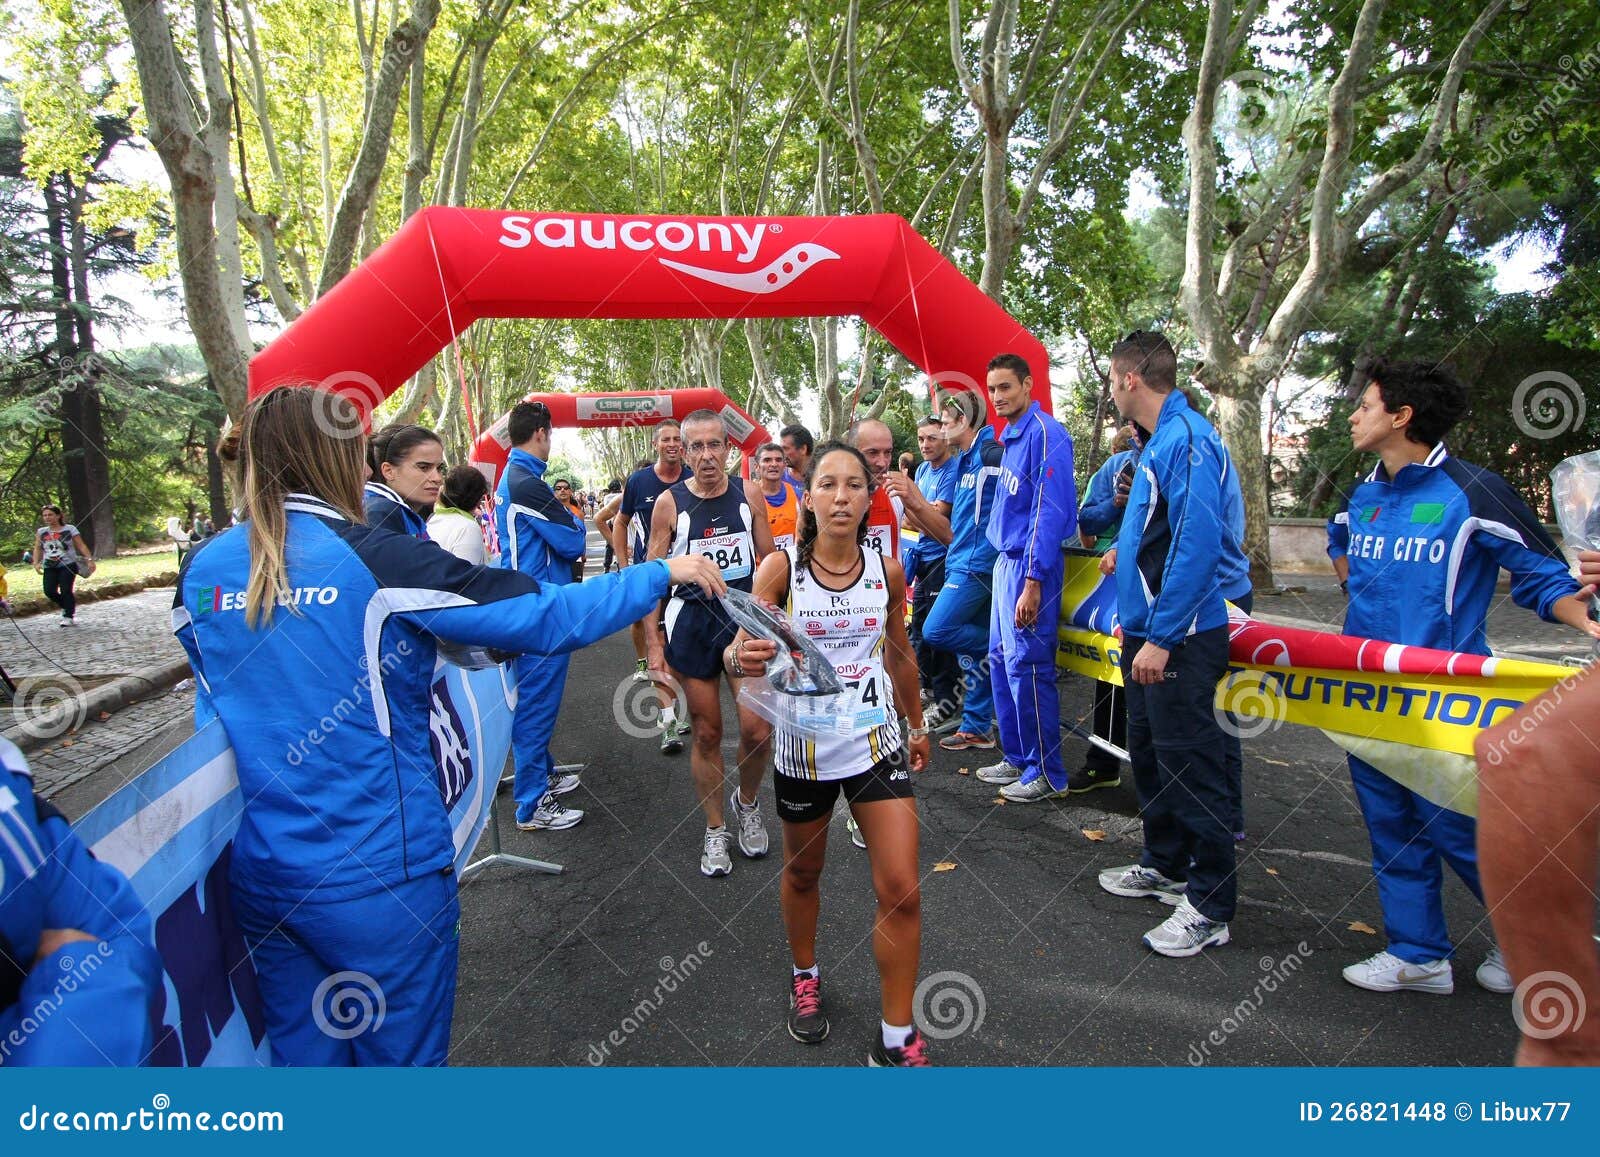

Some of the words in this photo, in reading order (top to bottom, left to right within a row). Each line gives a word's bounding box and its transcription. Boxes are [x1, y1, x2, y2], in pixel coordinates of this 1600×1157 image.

[1393, 536, 1445, 564] CITO
[221, 586, 338, 611] ESITO
[799, 608, 851, 618] PICCIONI
[853, 606, 882, 615] GROUP
[824, 640, 859, 649] VELLETRI
